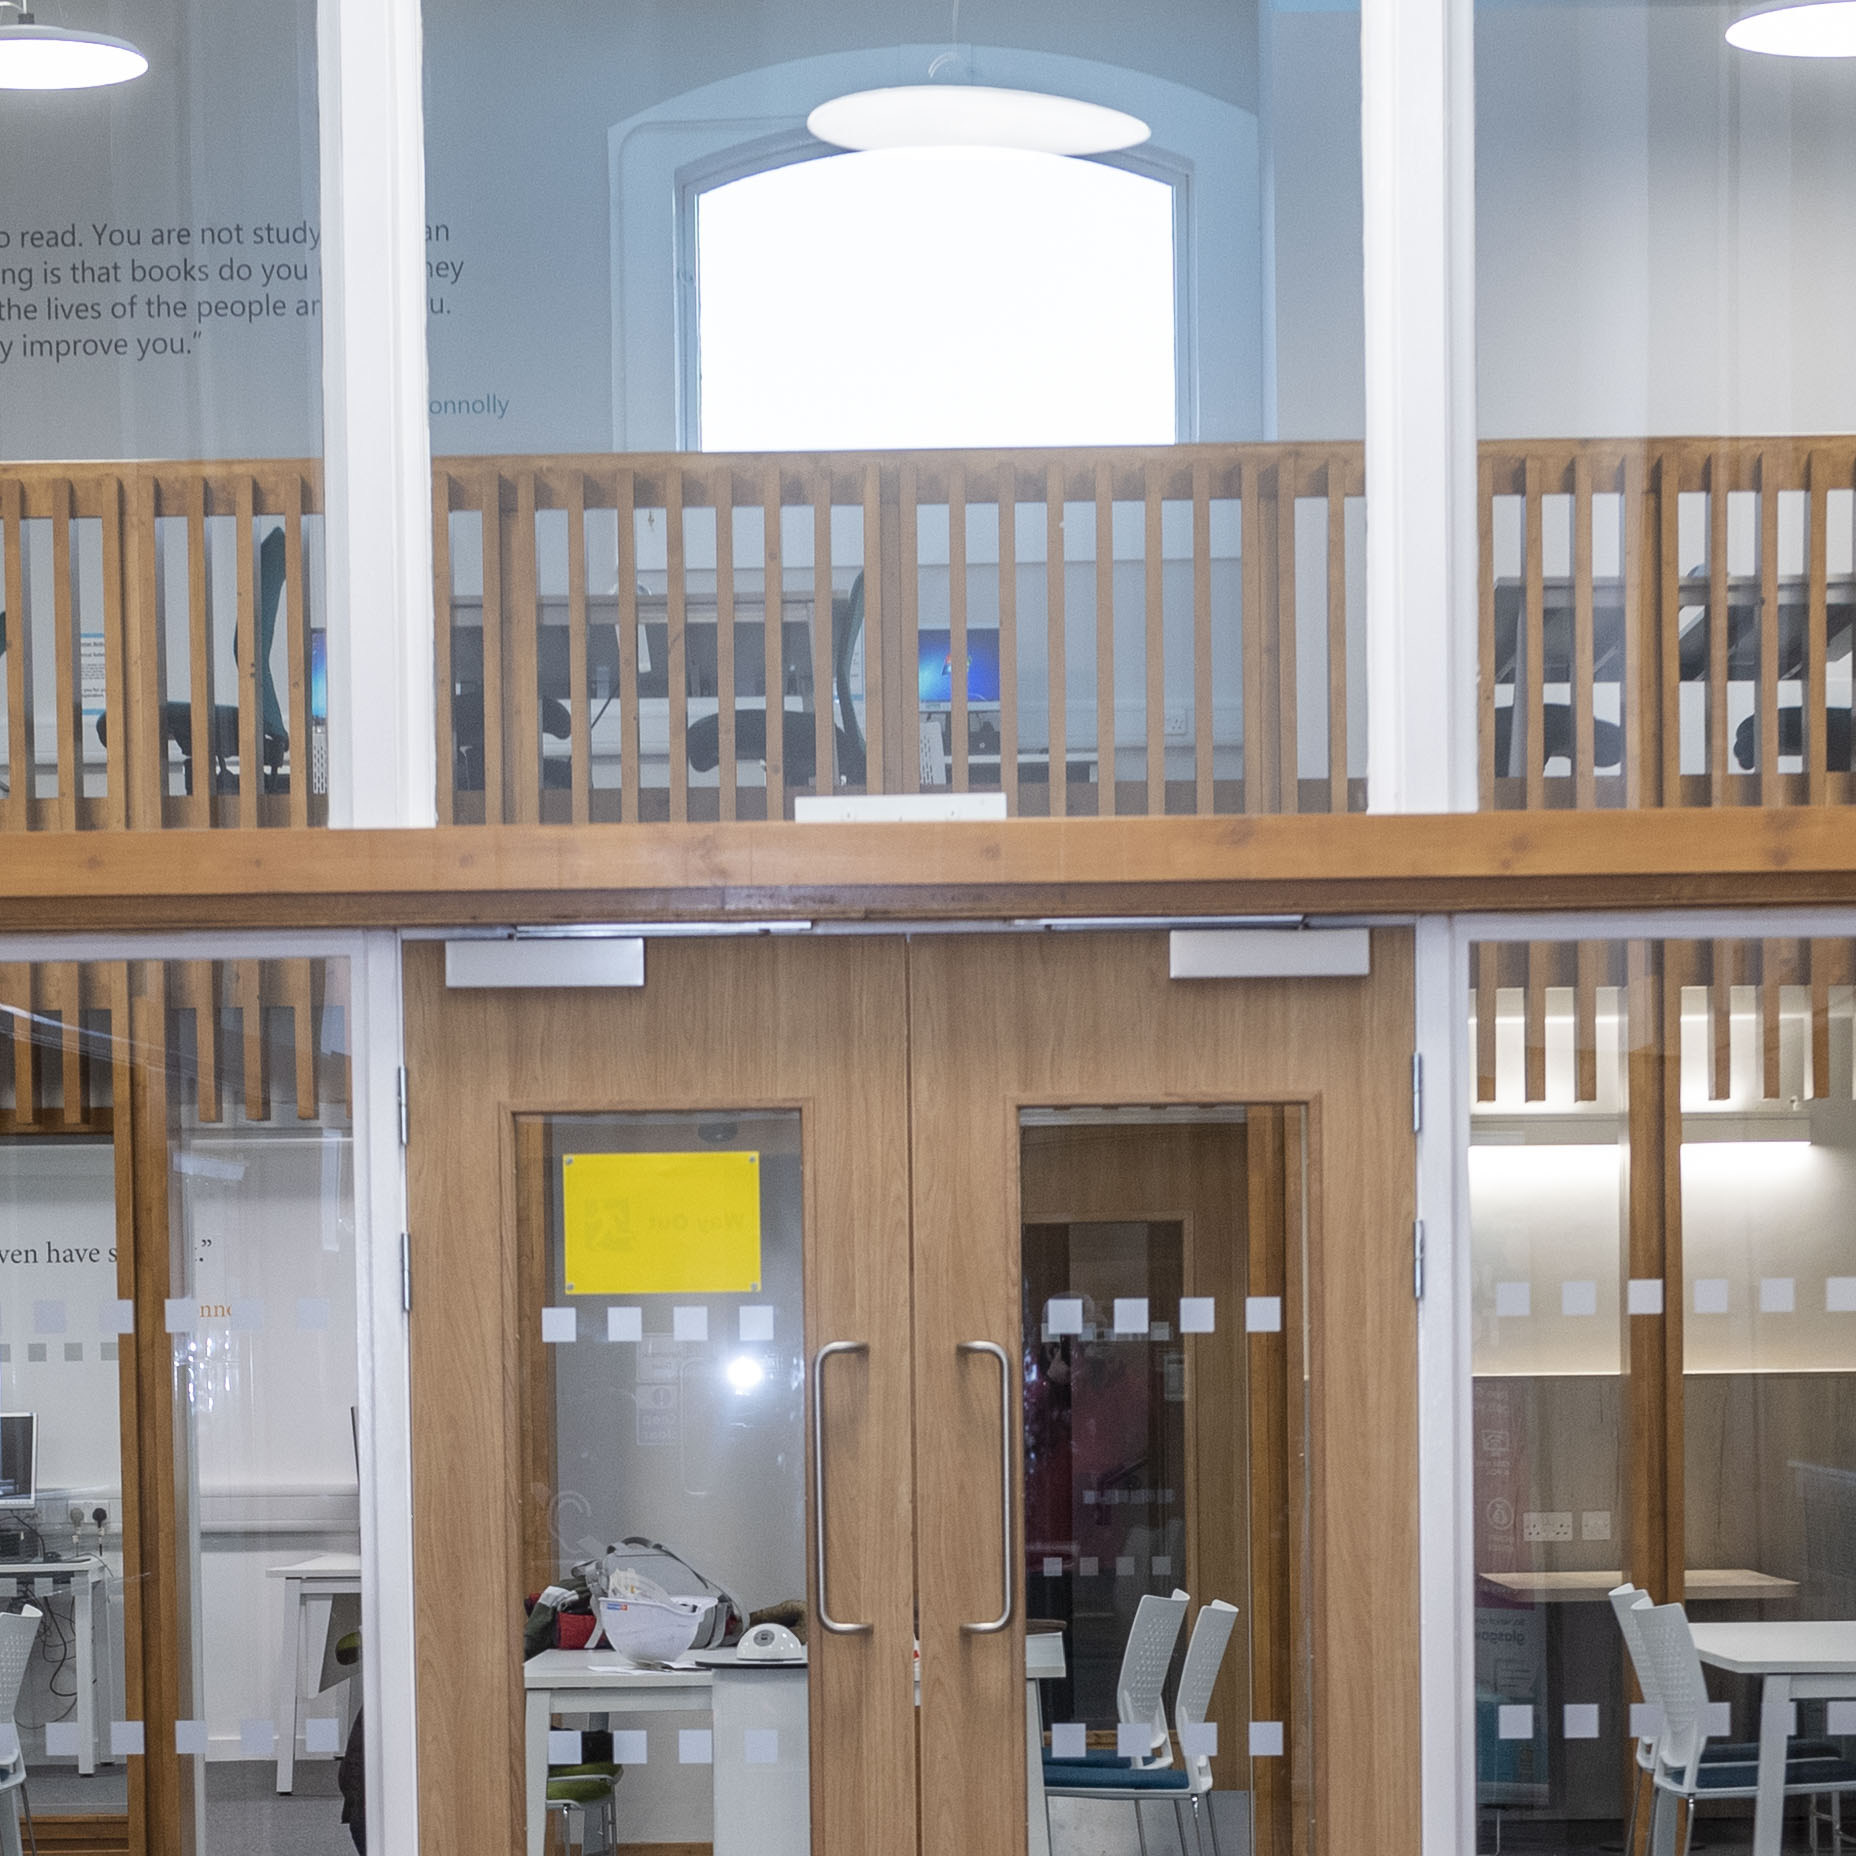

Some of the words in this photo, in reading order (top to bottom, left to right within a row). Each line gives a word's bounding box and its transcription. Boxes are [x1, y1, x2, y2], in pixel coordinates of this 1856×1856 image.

[21, 223, 84, 249] read.
[92, 223, 142, 246] You
[151, 227, 191, 245] are
[201, 223, 244, 245] not
[253, 220, 321, 250] study
[44, 260, 62, 285] is
[70, 260, 121, 284] that
[131, 258, 209, 283] books
[219, 257, 252, 281] do
[261, 262, 308, 287] you
[47, 296, 101, 321] lives
[111, 294, 137, 319] of
[147, 294, 187, 318] the
[197, 293, 286, 324] people
[22, 333, 128, 364] improve
[428, 394, 510, 420] onnolly
[45, 1240, 101, 1264] have
